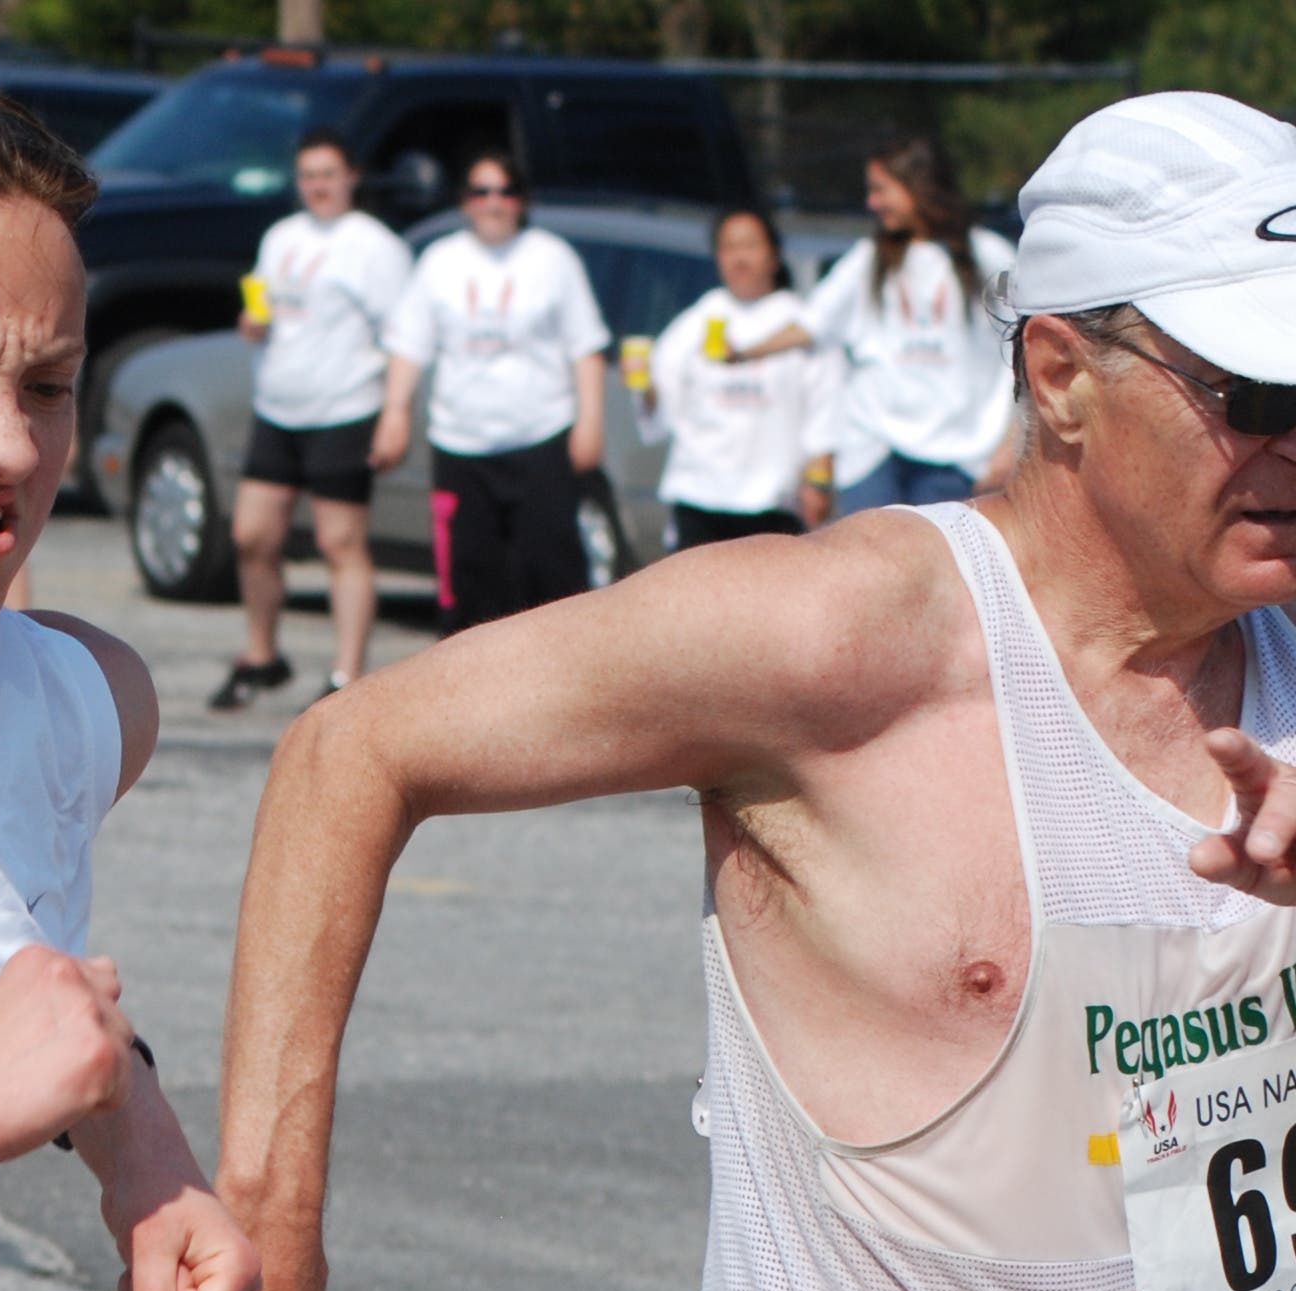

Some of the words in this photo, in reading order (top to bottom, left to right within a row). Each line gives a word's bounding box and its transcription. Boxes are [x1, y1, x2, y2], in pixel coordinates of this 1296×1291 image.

[1085, 995, 1268, 1085] Pegasus
[1195, 1086, 1253, 1127] USA
[1154, 1136, 1179, 1155] USA
